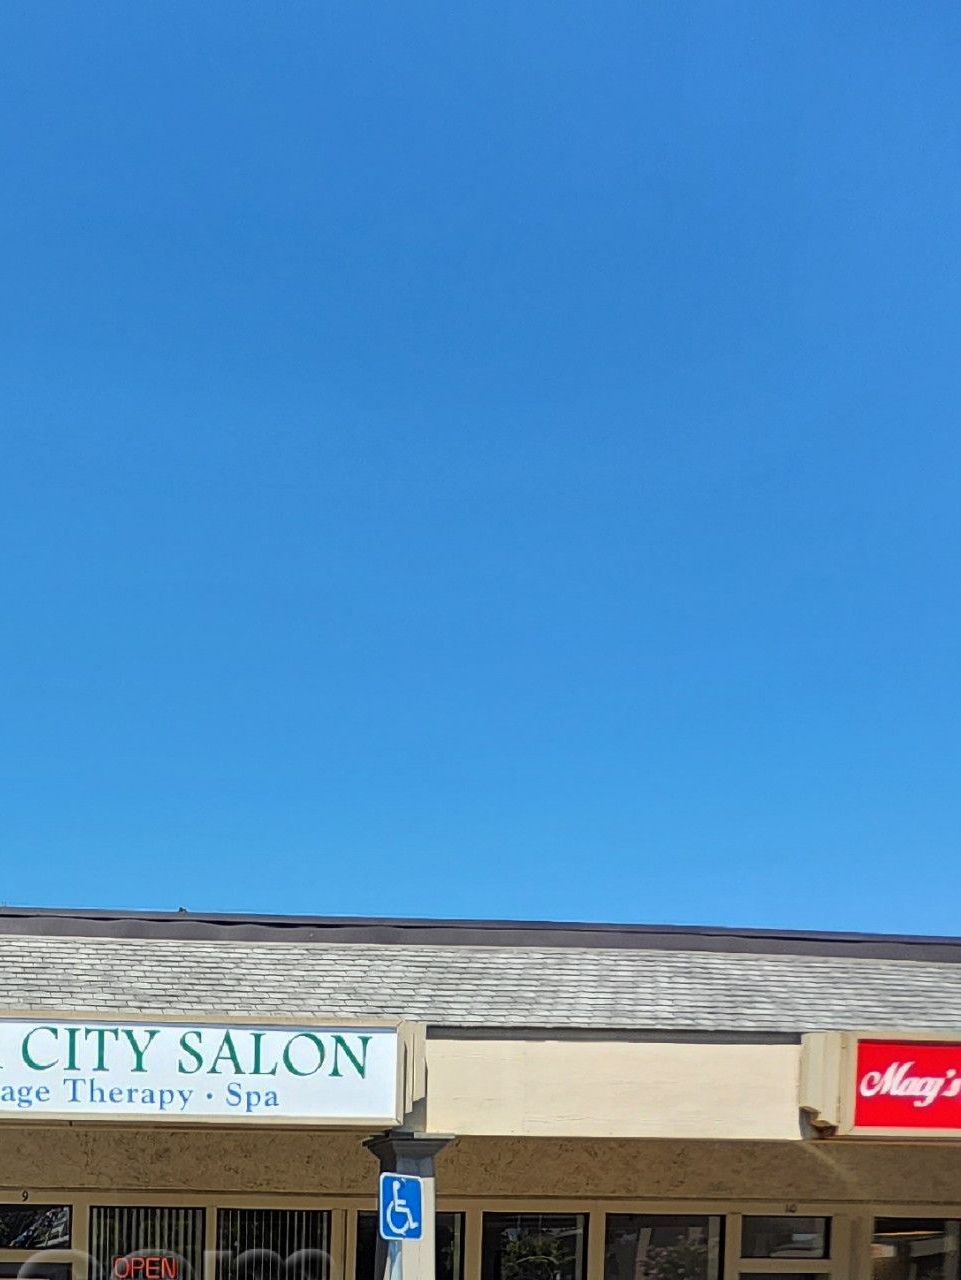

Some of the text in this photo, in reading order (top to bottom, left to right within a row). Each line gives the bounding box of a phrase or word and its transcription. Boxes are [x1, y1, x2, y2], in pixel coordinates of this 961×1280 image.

[21, 1026, 161, 1073] CITY
[178, 1029, 373, 1079] SALON
[63, 1078, 194, 1111] Therapy
[225, 1082, 280, 1113] Spa
[21, 1190, 29, 1202] 9
[113, 1256, 177, 1280] OPEN
